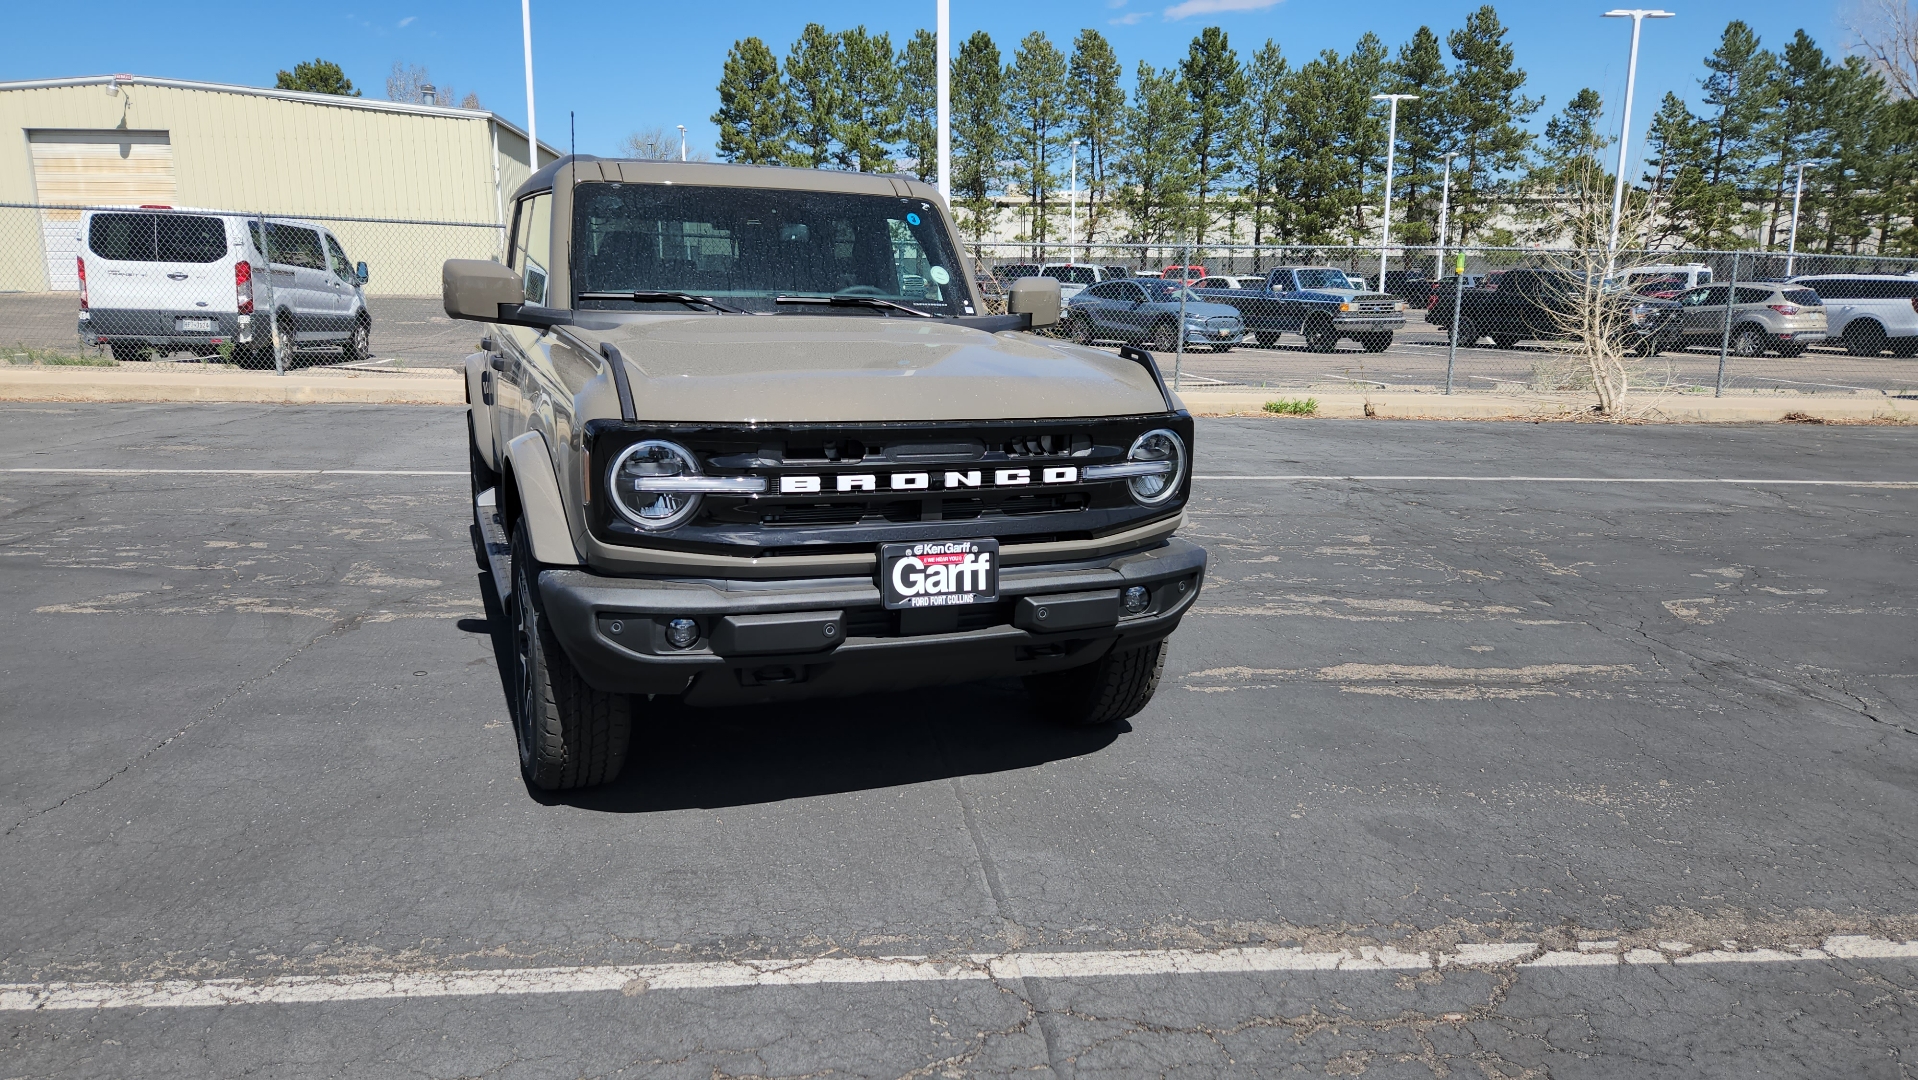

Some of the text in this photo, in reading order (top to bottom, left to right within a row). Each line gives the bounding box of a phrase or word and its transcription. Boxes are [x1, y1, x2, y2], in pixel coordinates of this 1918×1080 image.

[780, 466, 1078, 493] BRONCO
[924, 543, 945, 555] Ken
[945, 542, 971, 554] Garff
[892, 553, 990, 596] Garff
[911, 593, 974, 607] FORD FORT COLLINS
